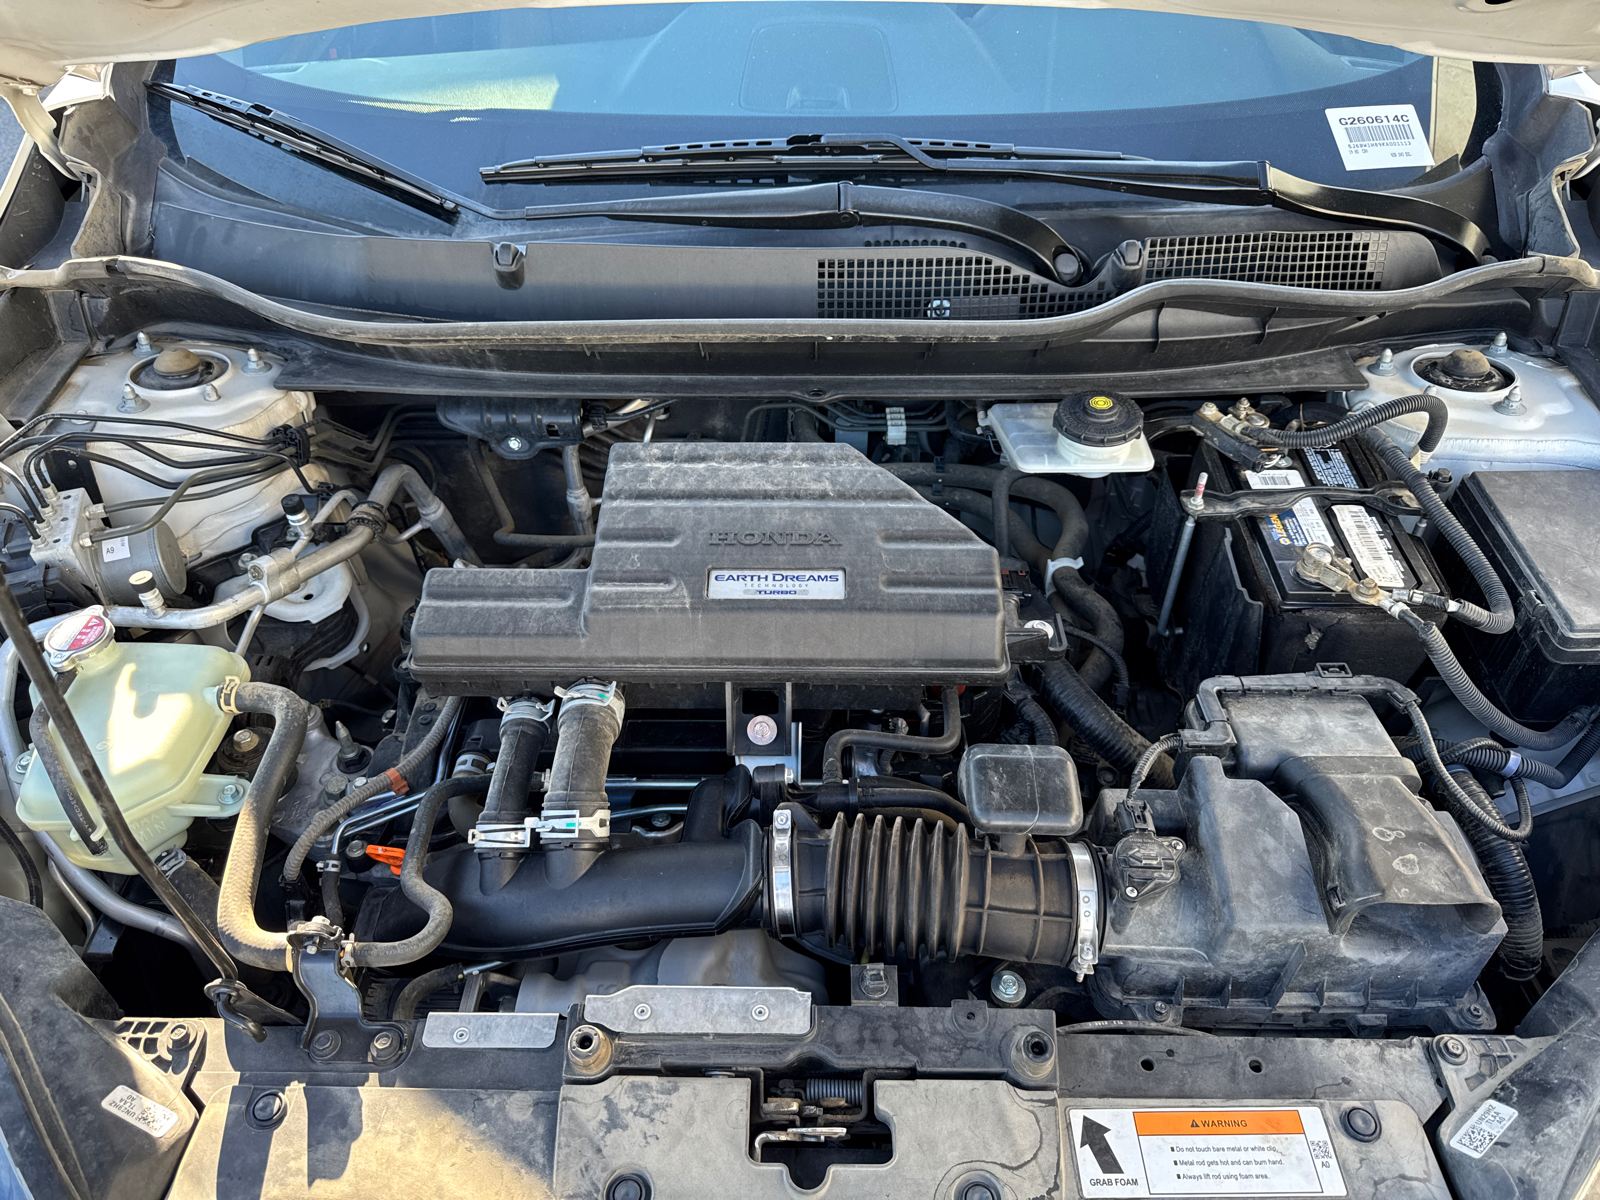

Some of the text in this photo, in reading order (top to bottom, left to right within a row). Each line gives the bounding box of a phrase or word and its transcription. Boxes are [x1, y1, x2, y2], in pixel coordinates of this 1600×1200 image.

[1338, 114, 1410, 126] G260614C
[1269, 514, 1287, 538] LEGEN
[708, 530, 843, 546] HONDA
[106, 546, 115, 555] A9
[714, 573, 840, 582] EARTH DREAMS
[119, 1097, 137, 1110] TLAA
[1485, 1111, 1501, 1125] TLAA
[1201, 1120, 1248, 1128] WARNING
[1090, 1178, 1139, 1186] GRAB FOAM
[1182, 1173, 1203, 1181] Always
[1222, 1173, 1239, 1181] using
